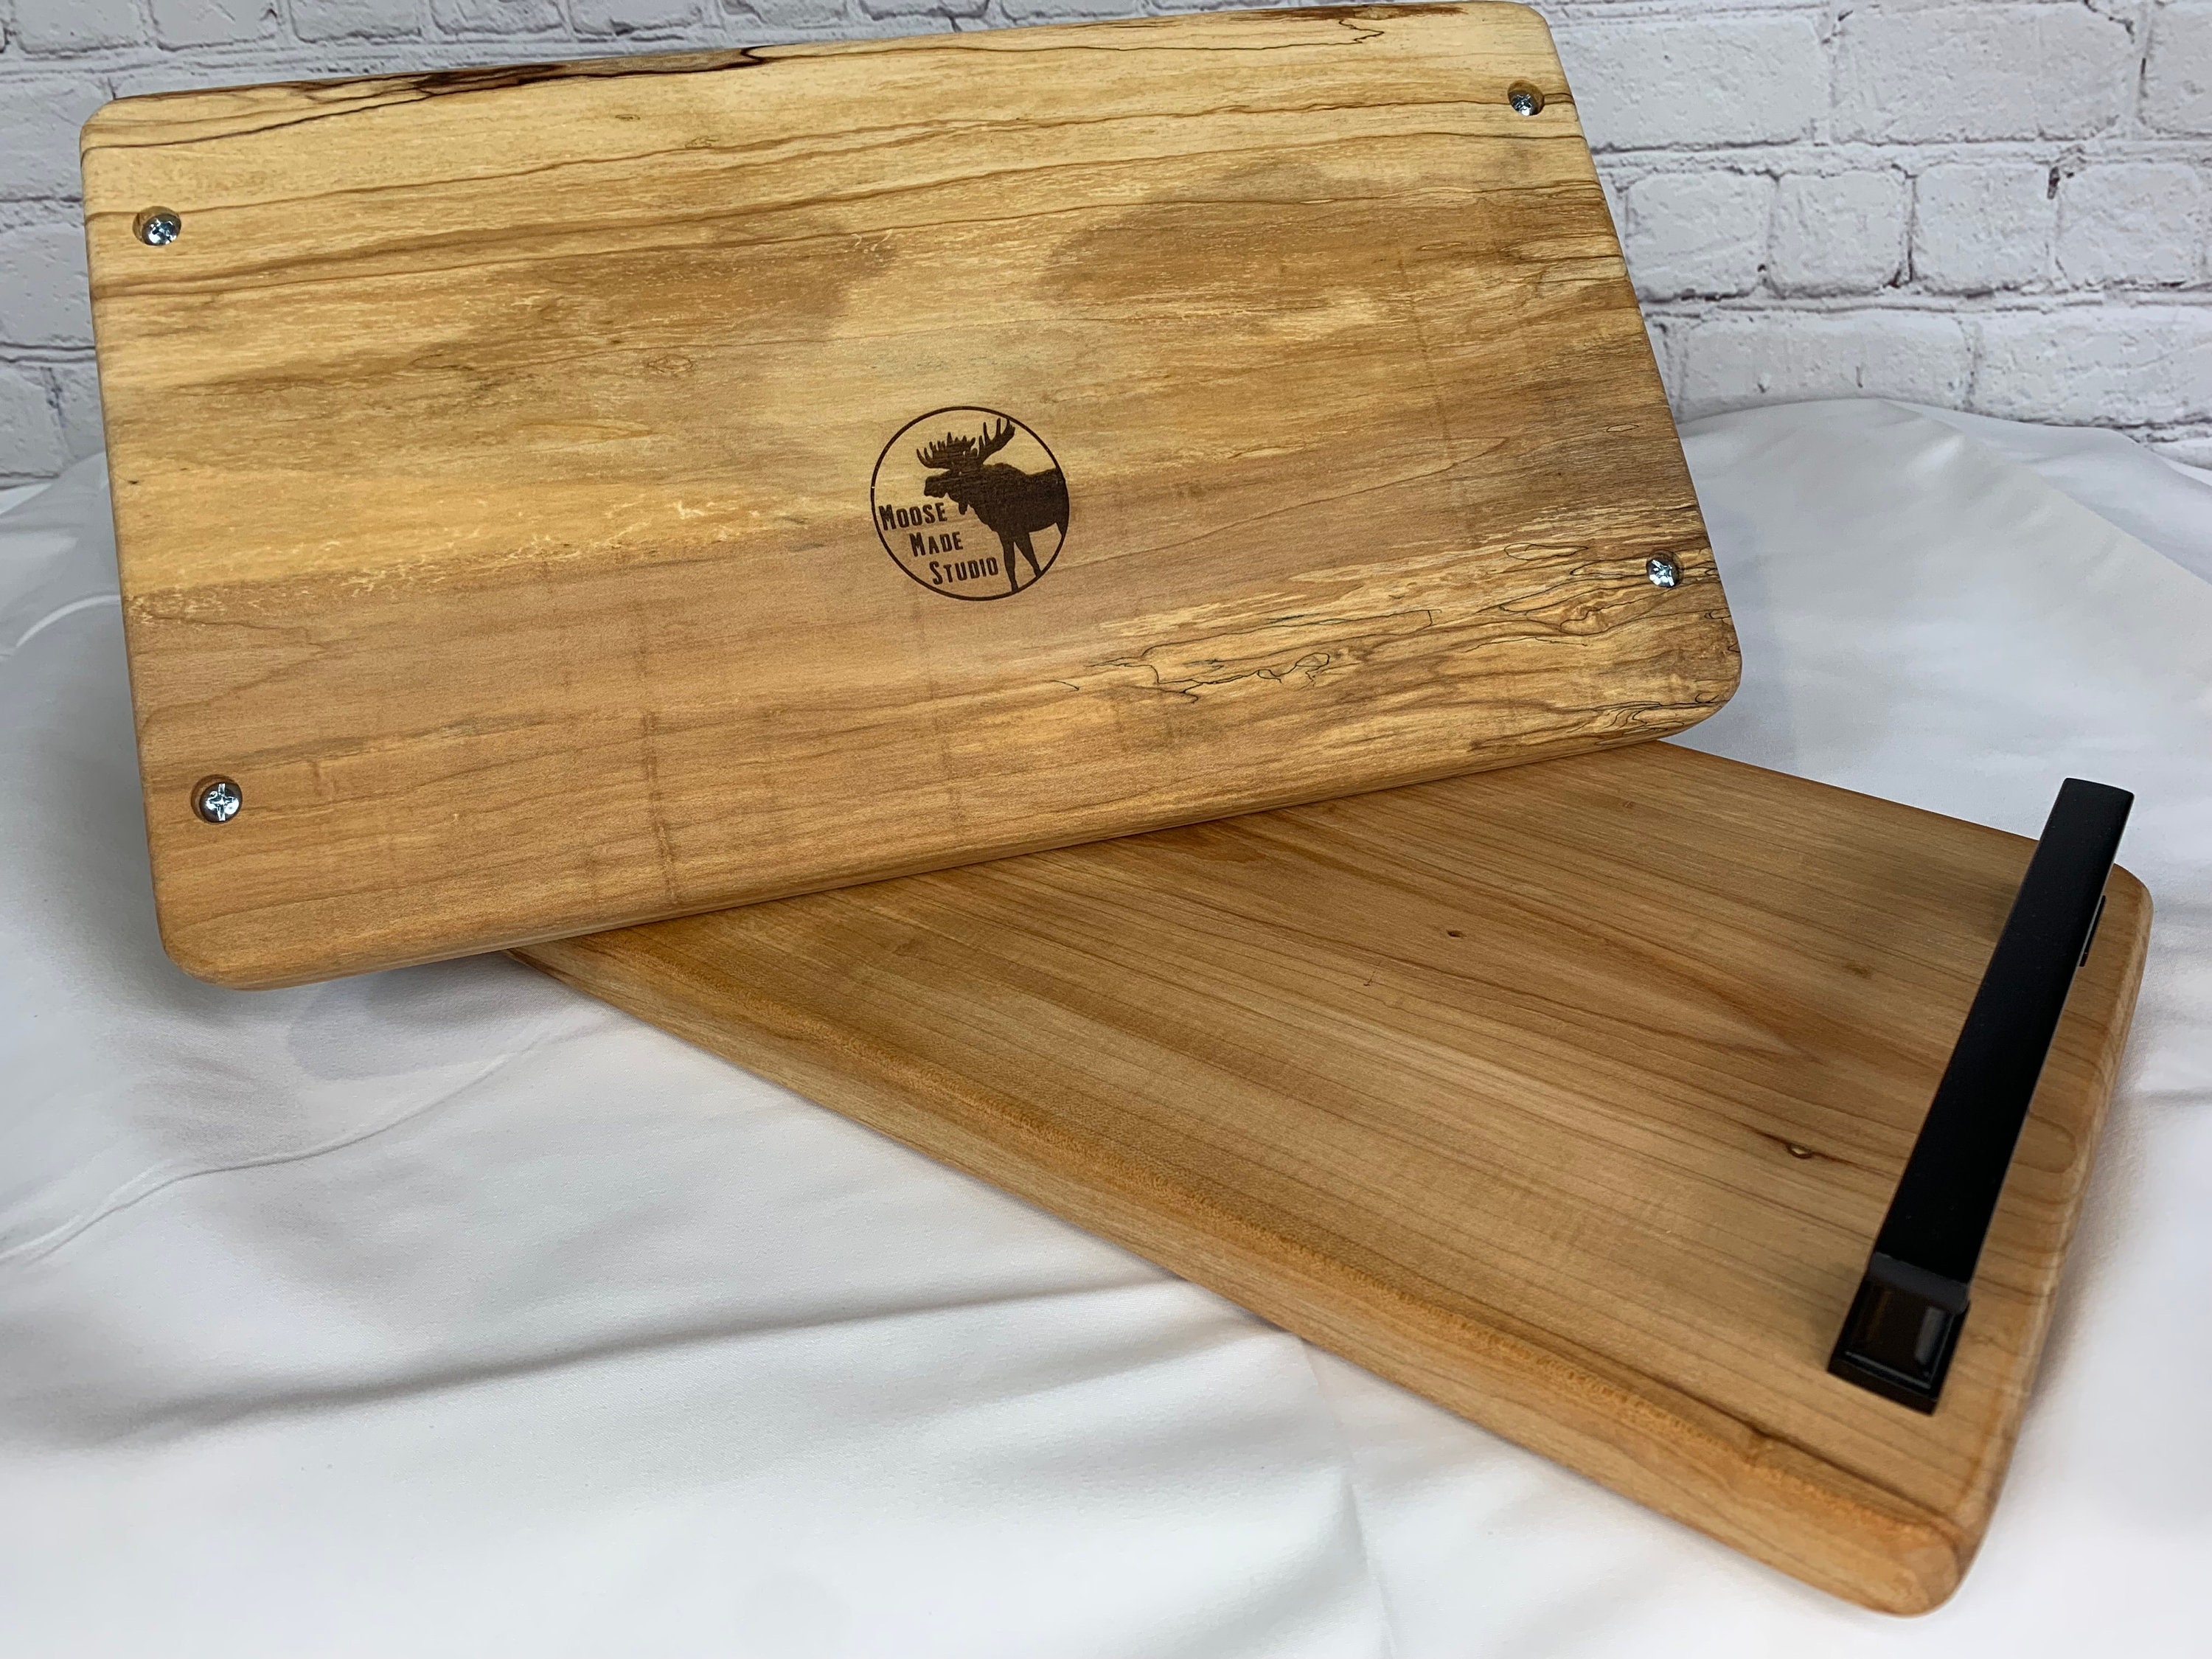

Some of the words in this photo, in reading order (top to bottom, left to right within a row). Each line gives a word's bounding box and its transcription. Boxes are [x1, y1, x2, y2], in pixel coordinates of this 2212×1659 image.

[878, 502, 948, 531] MOOSE
[909, 532, 964, 557] MADE
[929, 557, 999, 585] STUDIO
